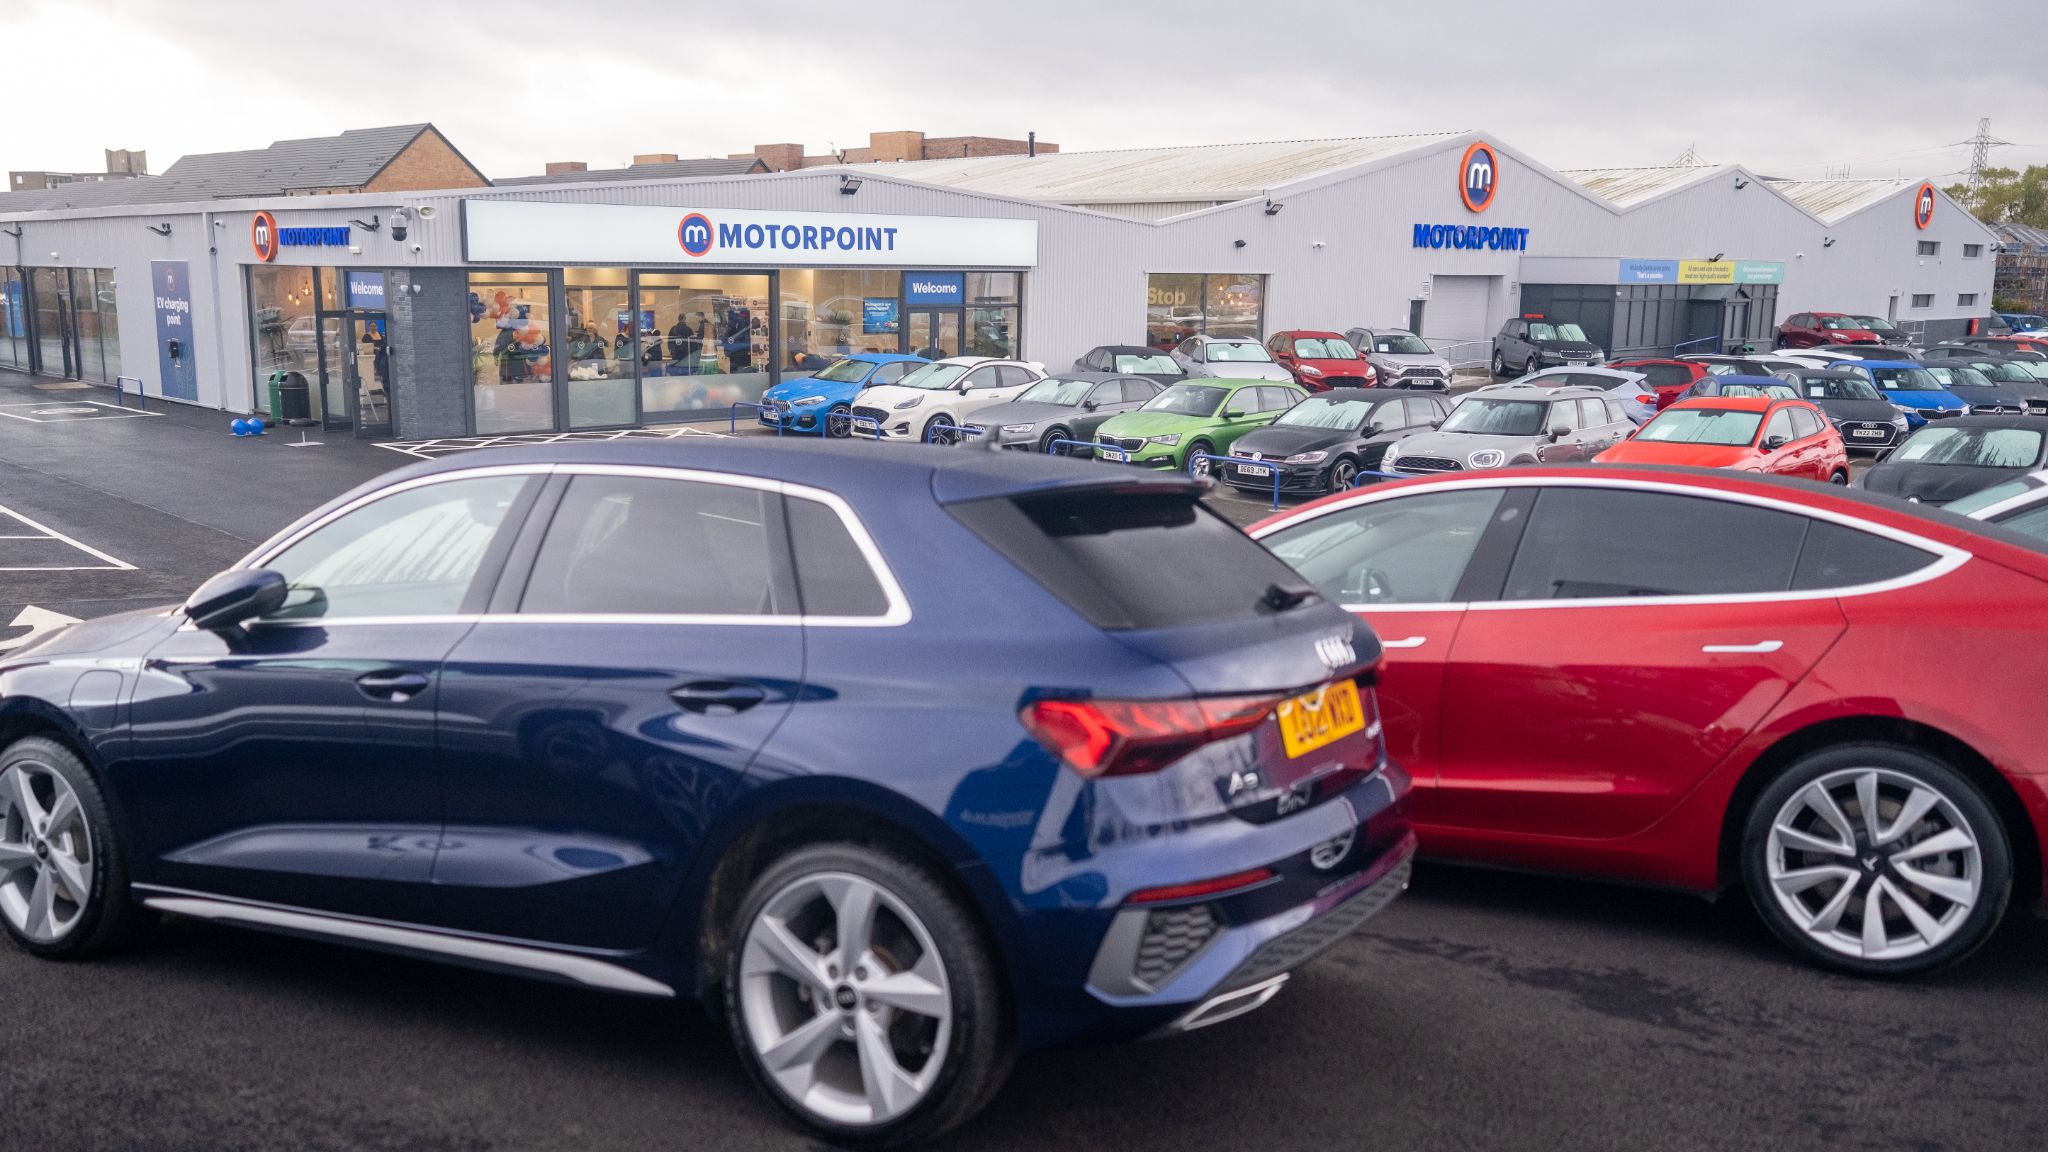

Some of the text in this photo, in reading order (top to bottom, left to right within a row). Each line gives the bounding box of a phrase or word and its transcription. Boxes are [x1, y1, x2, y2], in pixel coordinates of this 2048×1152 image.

[279, 226, 350, 246] MOTORPOINT
[719, 223, 898, 251] MOTORPOINT
[1413, 223, 1530, 251] MOTORPOINT
[350, 280, 384, 296] Welcome
[912, 281, 958, 294] Welcome
[1147, 286, 1186, 308] Stop
[156, 296, 189, 314] EV charging
[166, 312, 181, 327] point
